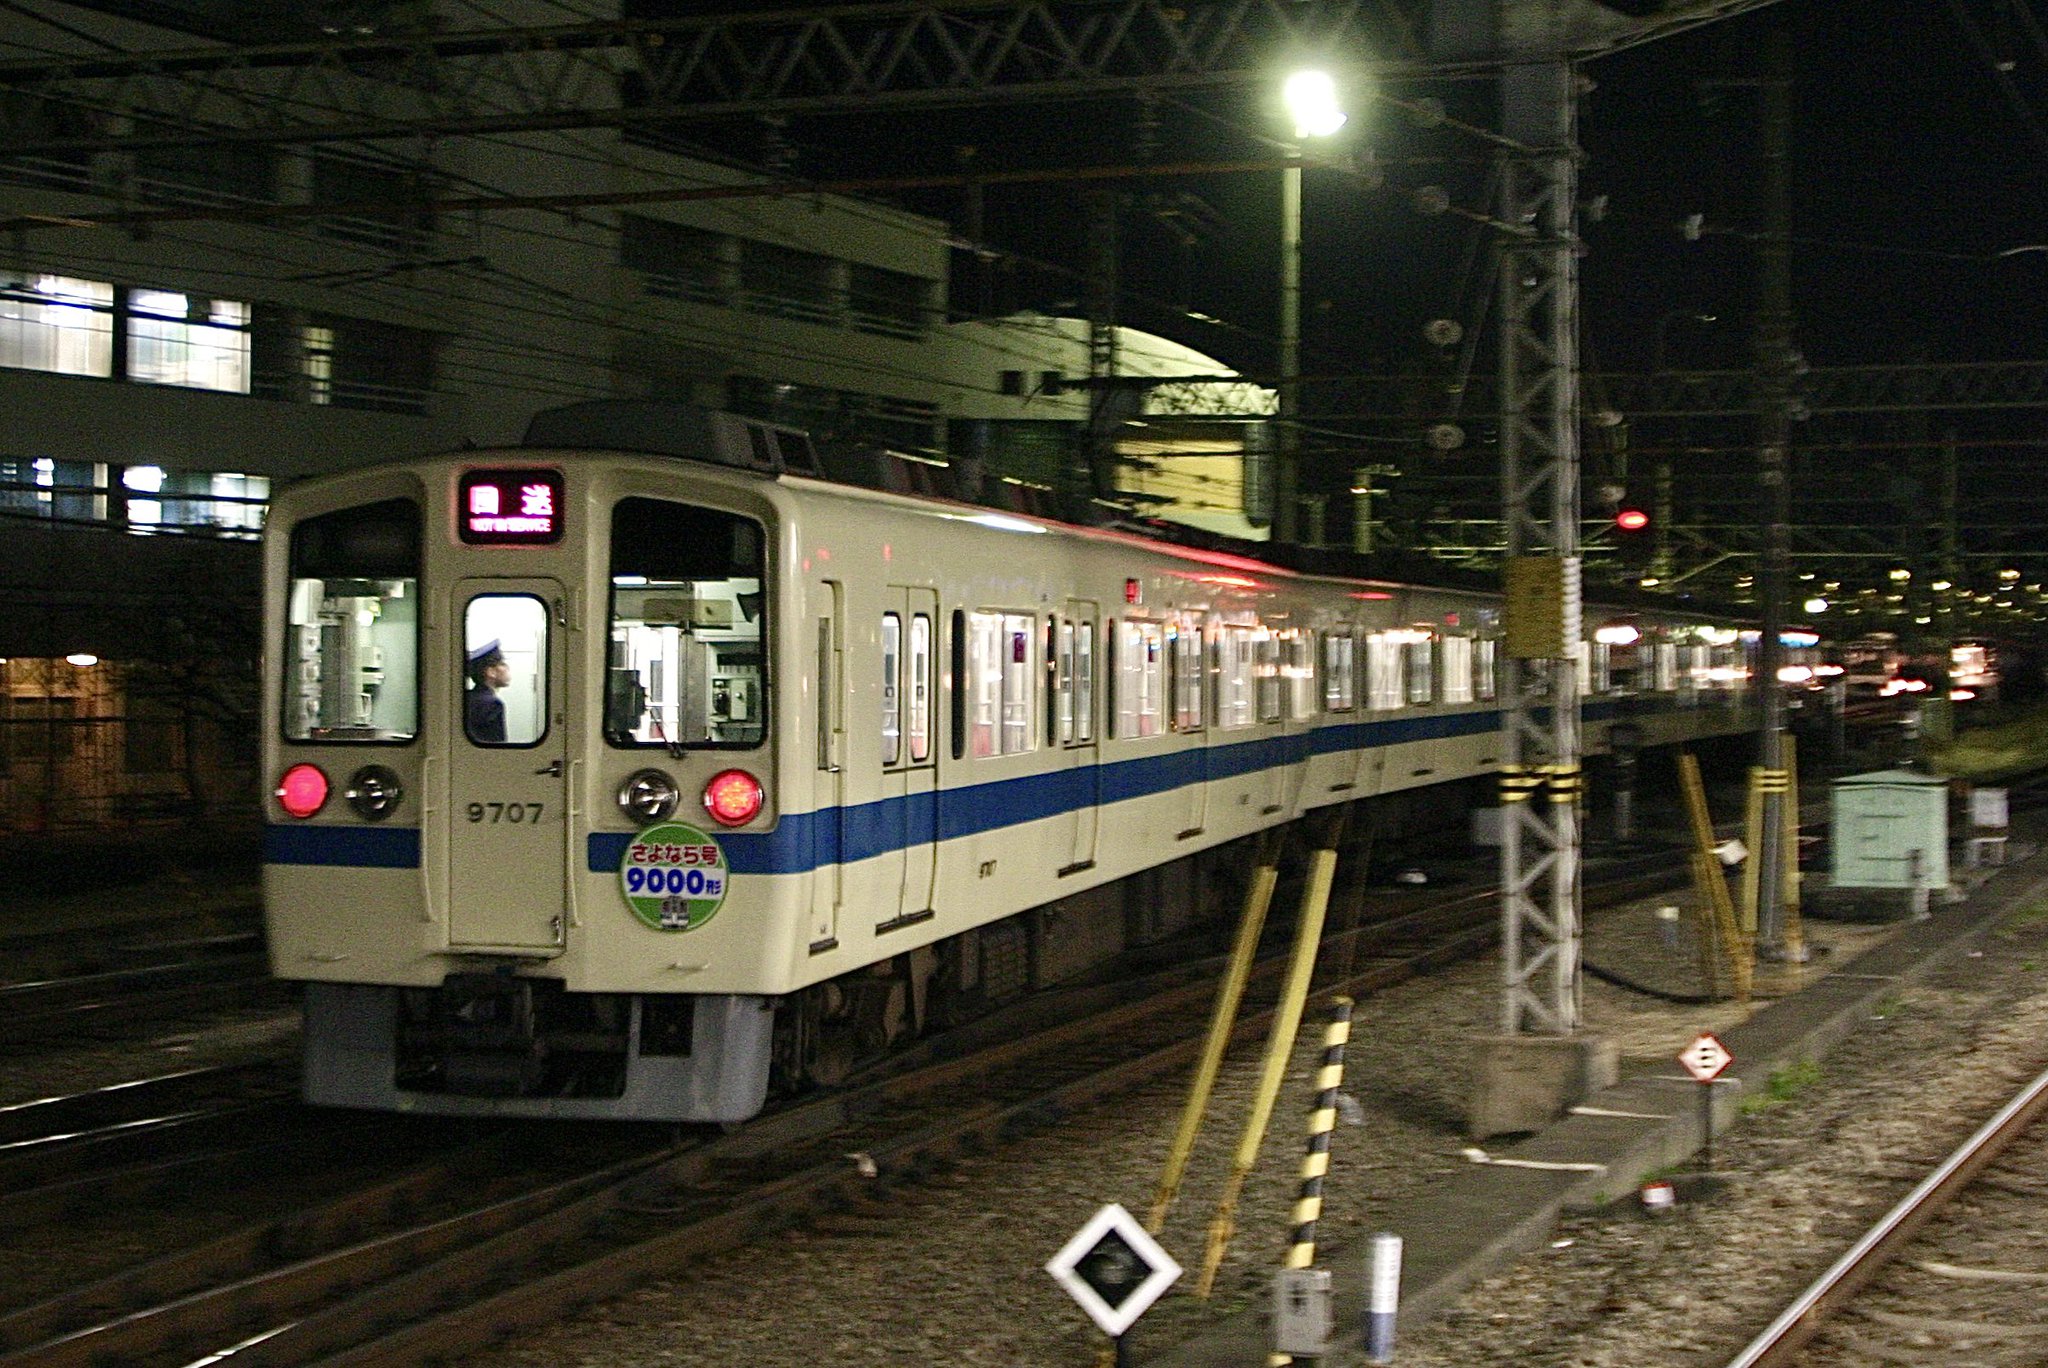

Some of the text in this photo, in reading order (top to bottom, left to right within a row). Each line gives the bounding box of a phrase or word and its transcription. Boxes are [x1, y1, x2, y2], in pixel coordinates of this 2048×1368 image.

[469, 485, 553, 515] 回送
[469, 518, 493, 532] NOT
[508, 518, 552, 532] SERVICE
[466, 802, 544, 824] 9707
[631, 844, 718, 866] さよなら号
